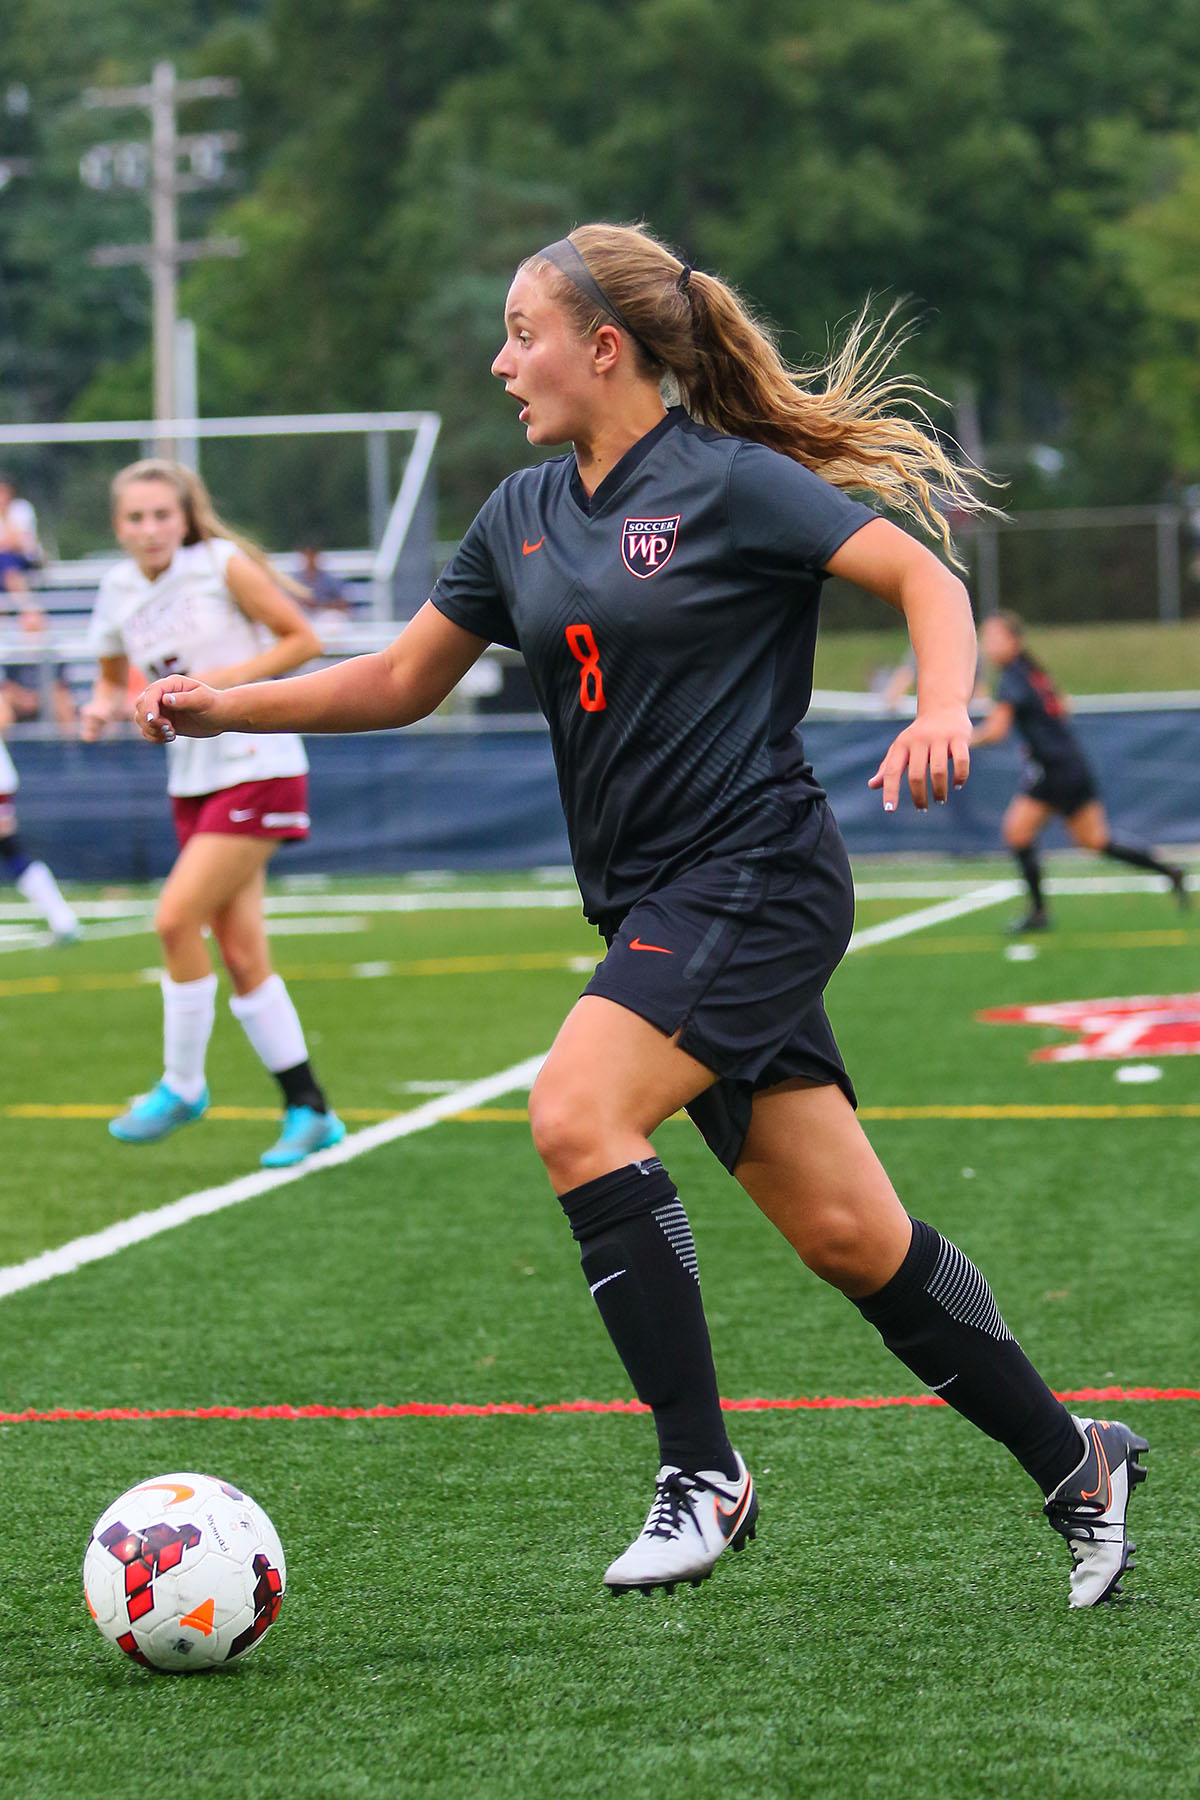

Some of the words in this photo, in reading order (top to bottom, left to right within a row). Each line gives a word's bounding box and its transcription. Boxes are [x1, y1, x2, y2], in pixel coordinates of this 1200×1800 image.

[628, 521, 674, 531] SOCCER
[628, 534, 667, 566] WP
[565, 624, 607, 712] 8
